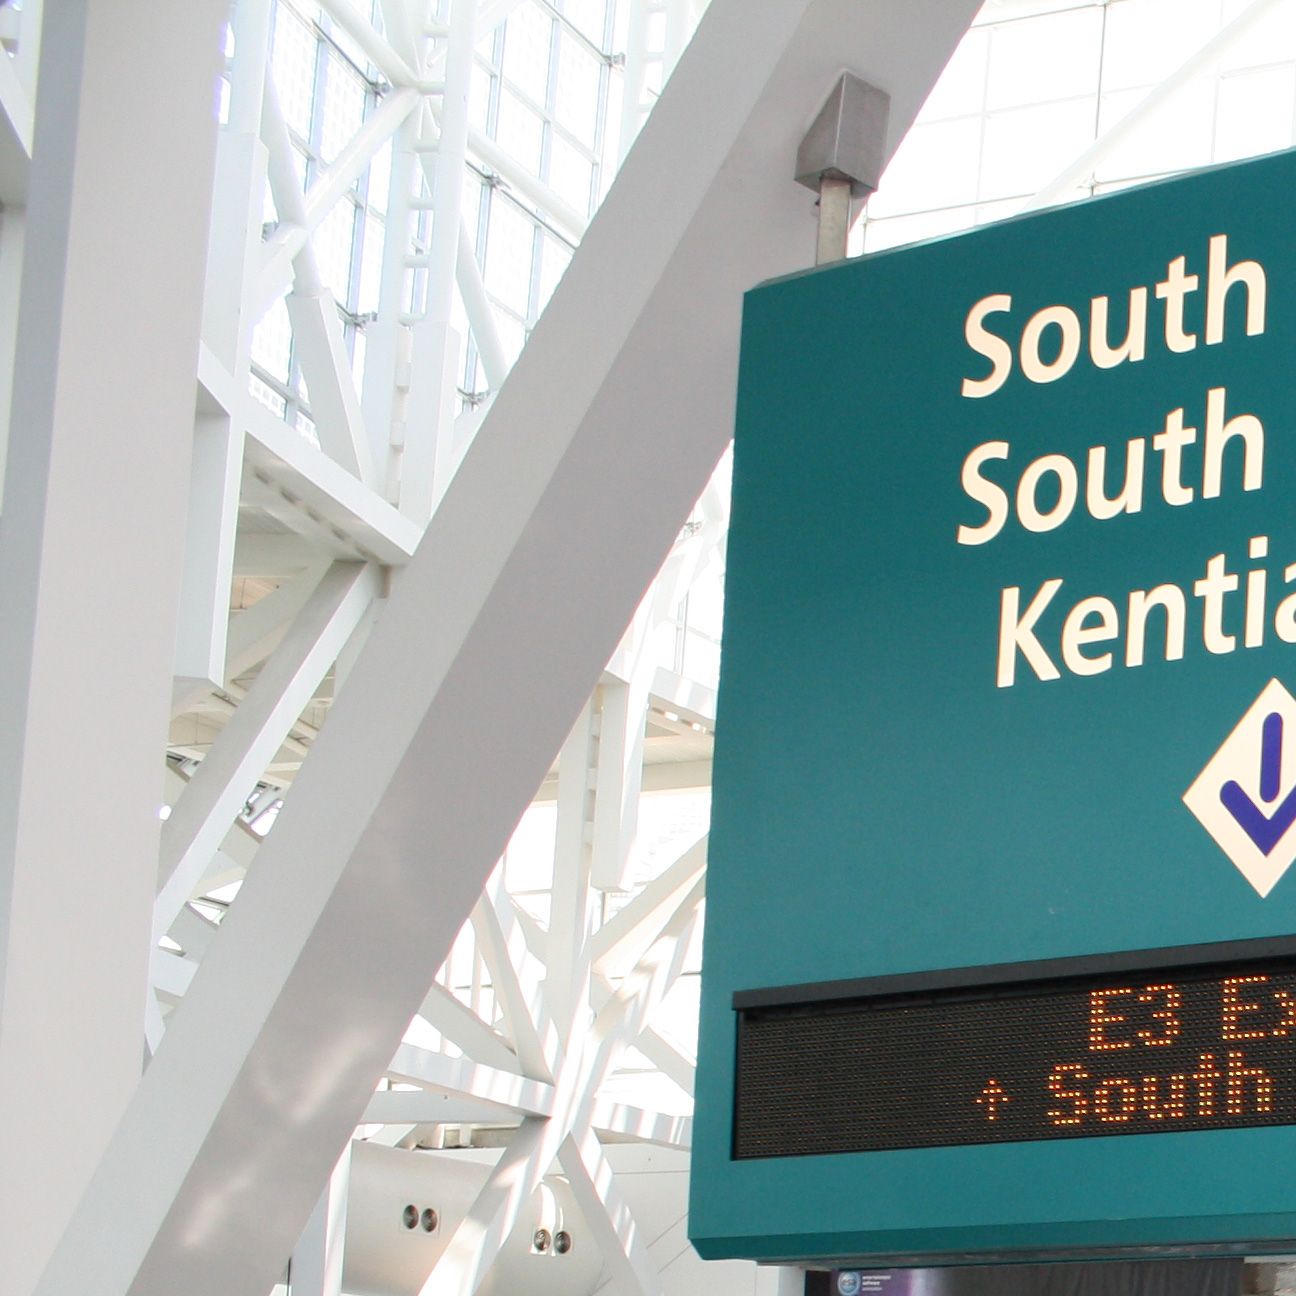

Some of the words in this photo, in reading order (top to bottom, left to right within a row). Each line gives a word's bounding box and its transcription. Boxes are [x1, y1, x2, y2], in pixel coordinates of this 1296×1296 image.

[959, 232, 1267, 398] South
[956, 391, 1264, 547] South
[1088, 981, 1182, 1052] E3
[1046, 1044, 1274, 1126] South
